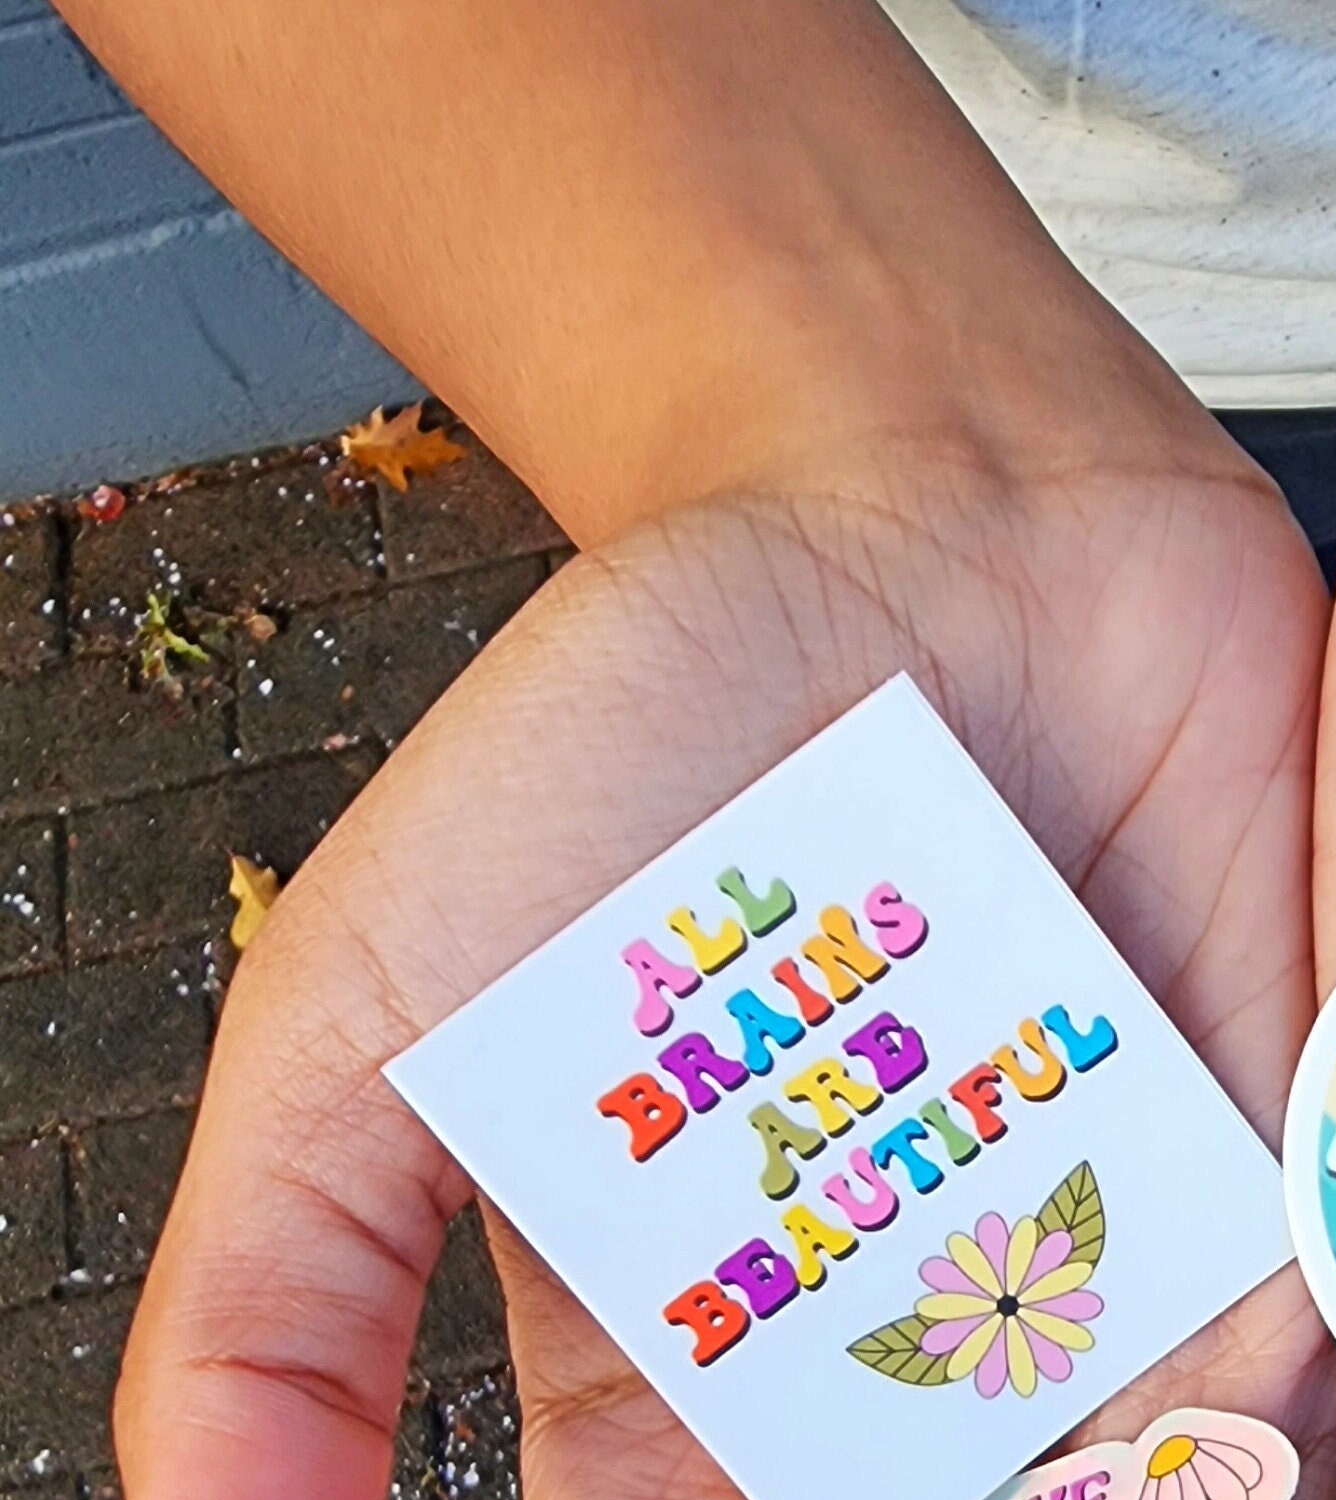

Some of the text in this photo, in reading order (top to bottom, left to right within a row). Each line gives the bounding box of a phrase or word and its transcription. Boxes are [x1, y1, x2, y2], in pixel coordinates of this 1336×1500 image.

[597, 880, 929, 1163] BRAINS
[621, 865, 797, 1037] ALL
[663, 1004, 1119, 1367] BEAUTIFUL
[747, 1010, 929, 1200] ARE
